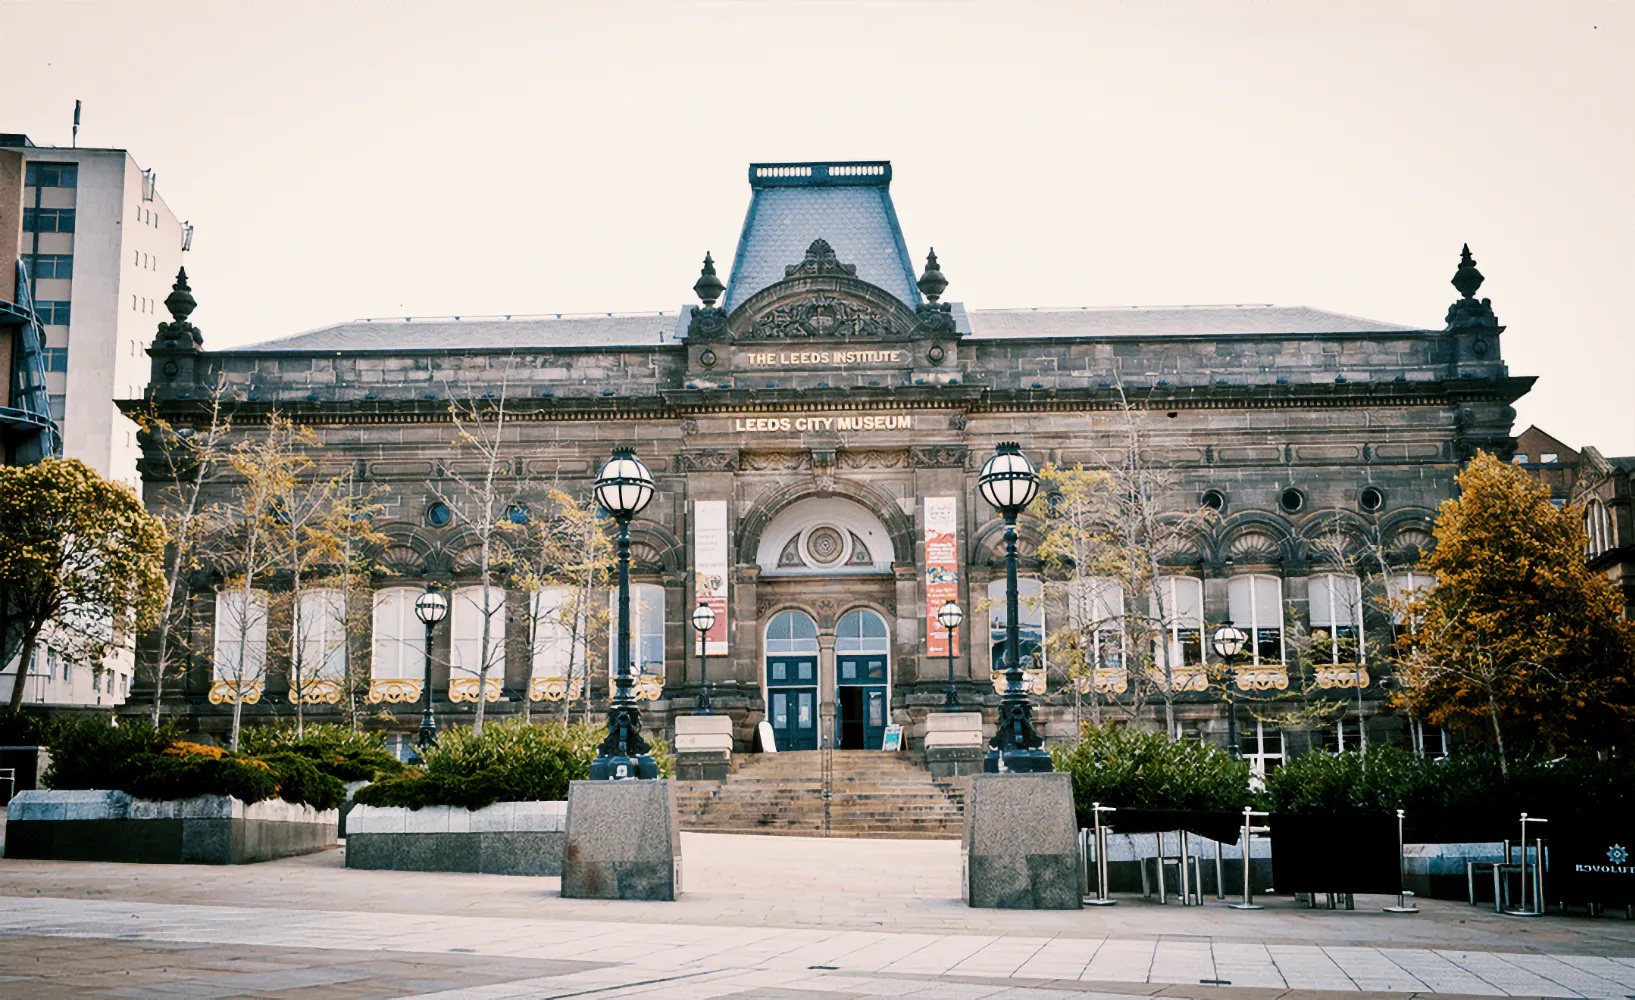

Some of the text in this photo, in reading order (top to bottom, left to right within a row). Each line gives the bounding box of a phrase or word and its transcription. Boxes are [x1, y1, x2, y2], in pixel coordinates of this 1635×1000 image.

[748, 350, 900, 365] THE LEEDS INSTITUTE
[735, 415, 911, 432] LEEDS CITY MUSEUM
